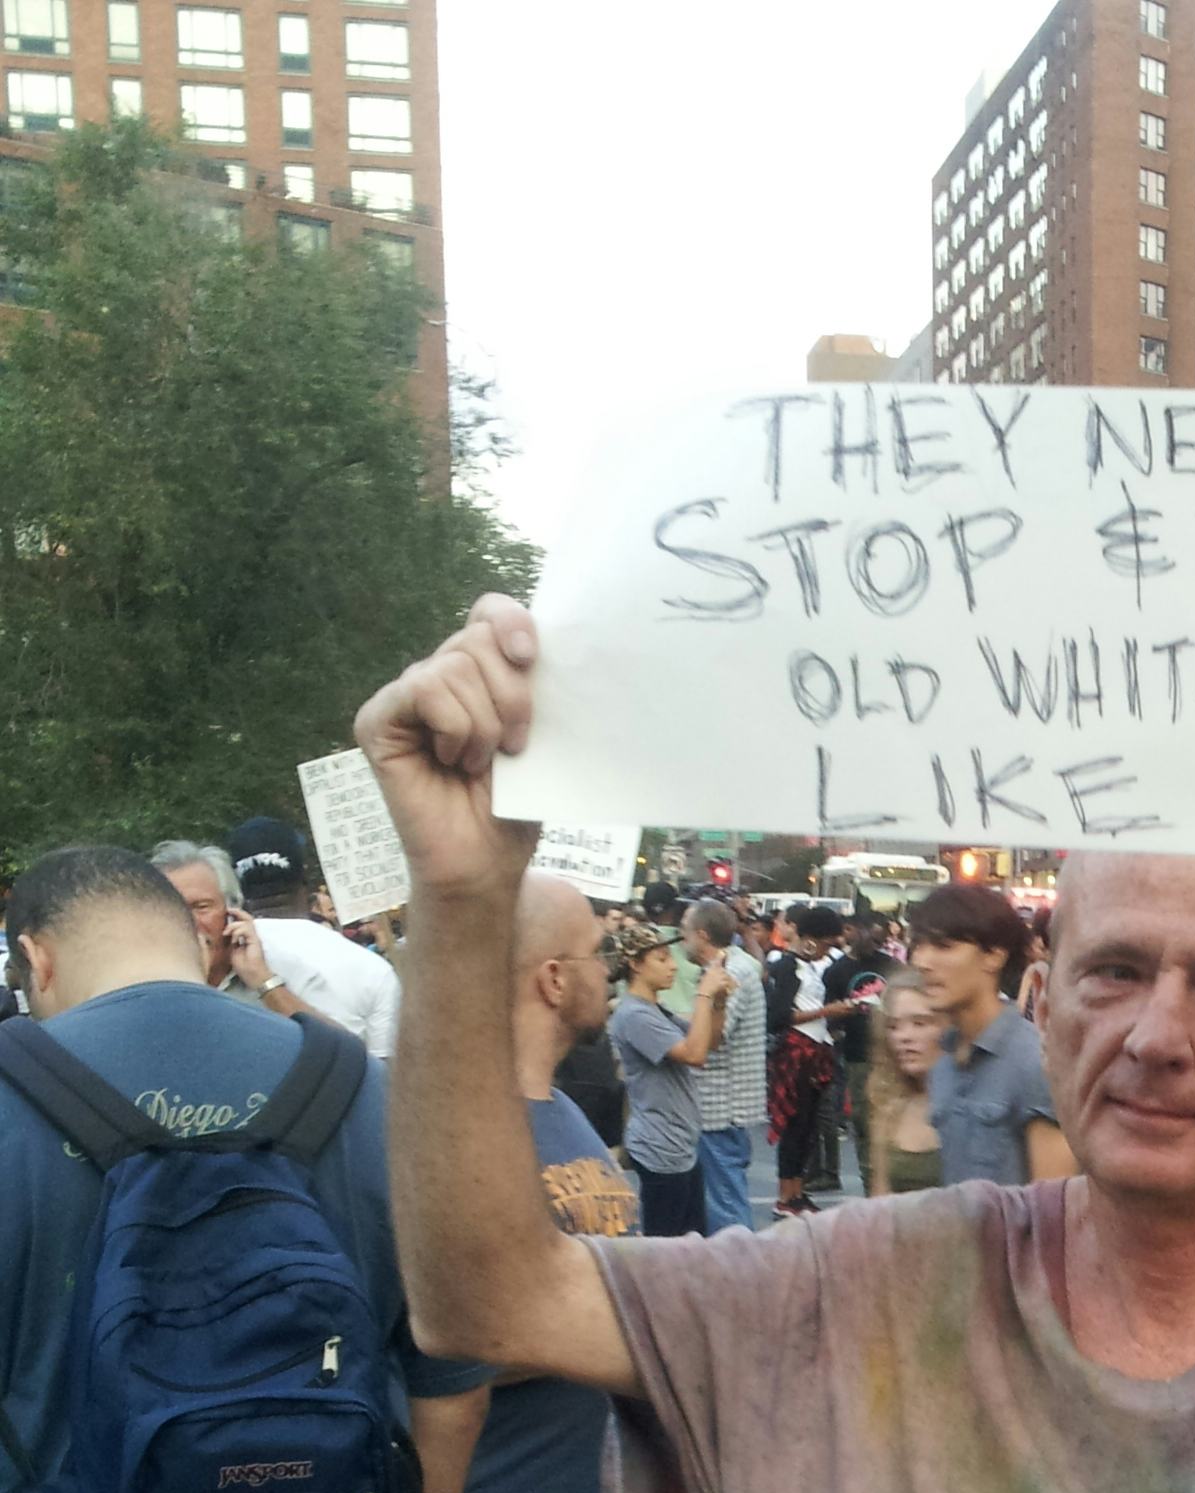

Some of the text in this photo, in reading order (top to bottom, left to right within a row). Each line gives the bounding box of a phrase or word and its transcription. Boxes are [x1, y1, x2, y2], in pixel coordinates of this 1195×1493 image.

[728, 384, 1033, 501] THEY
[652, 497, 1028, 622] STOP
[788, 648, 942, 726] OLD
[815, 744, 1176, 837] LIKE
[135, 1088, 239, 1137] Diego
[217, 1461, 313, 1489] JANSPORT
